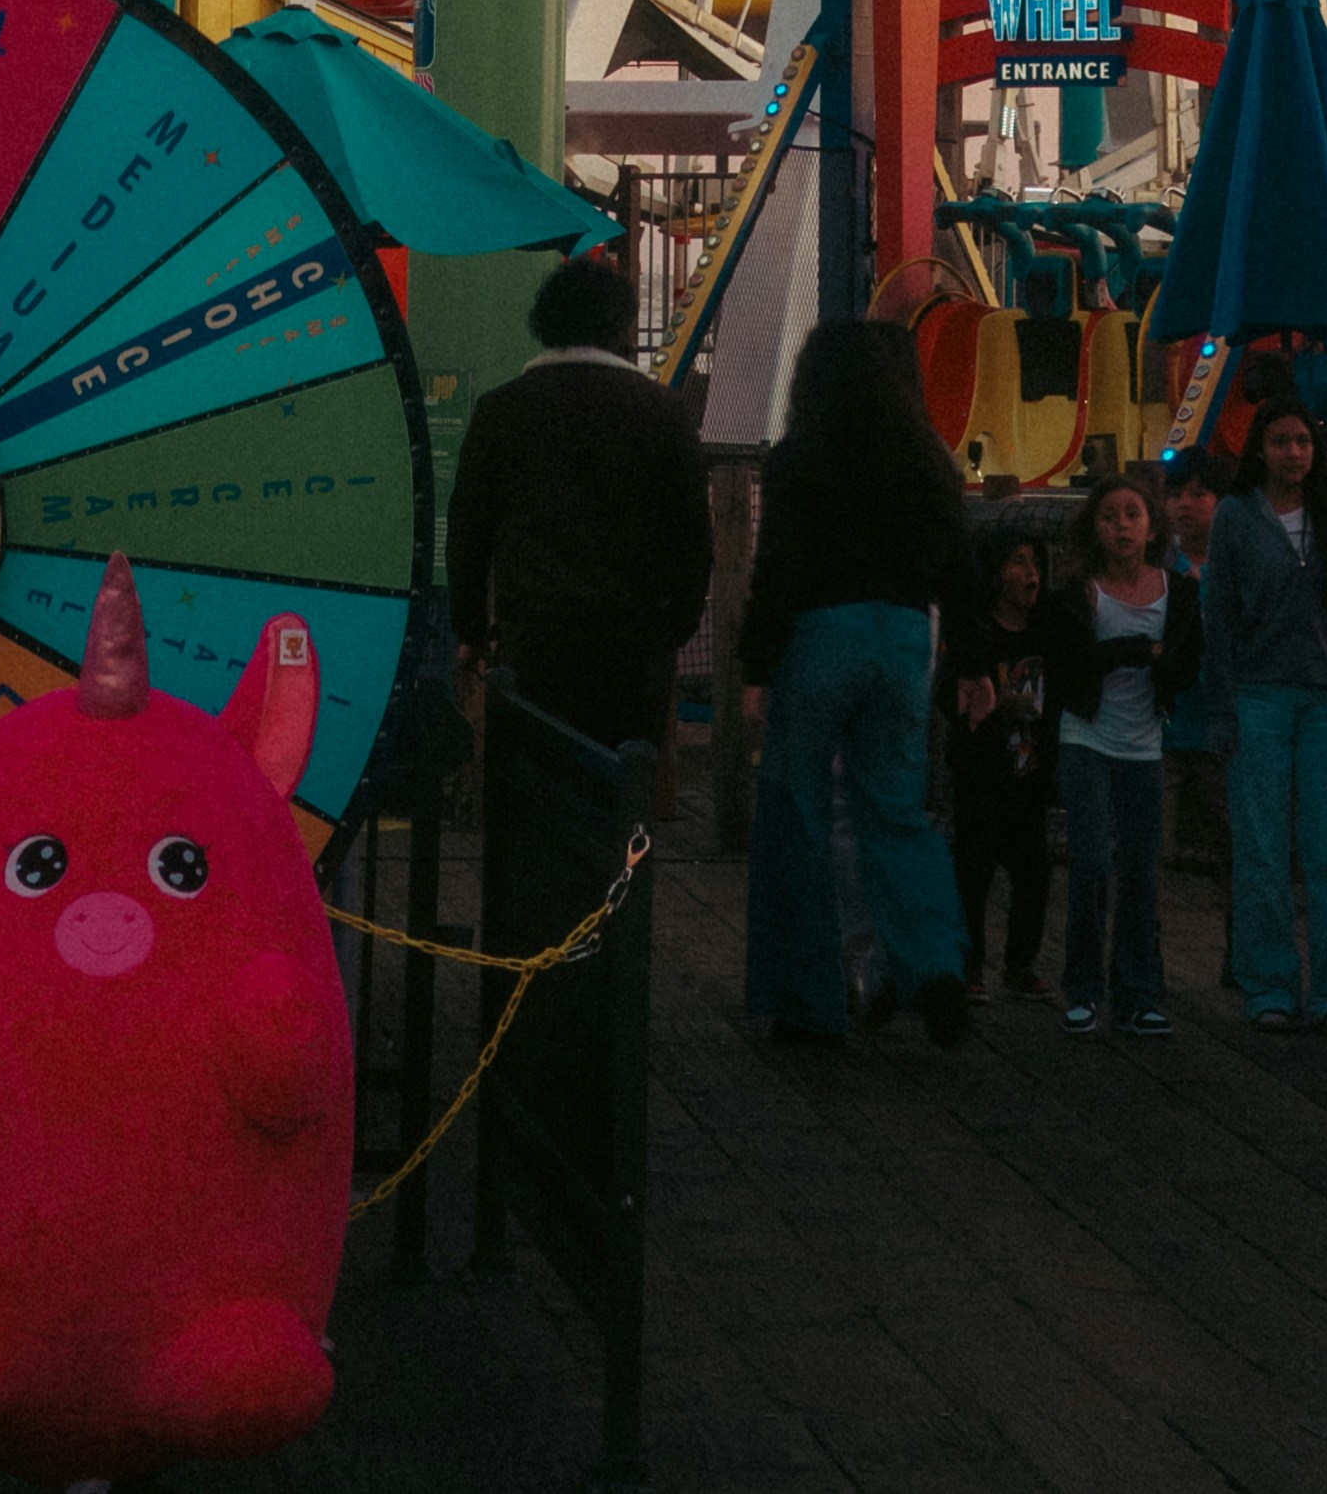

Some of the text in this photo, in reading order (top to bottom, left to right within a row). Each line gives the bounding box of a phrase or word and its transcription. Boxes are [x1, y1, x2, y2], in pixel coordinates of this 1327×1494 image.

[1000, 61, 1111, 82] ENTRANCE
[205, 212, 304, 288] SMALL
[71, 259, 325, 397] CHOICE
[235, 314, 349, 357] SMALL
